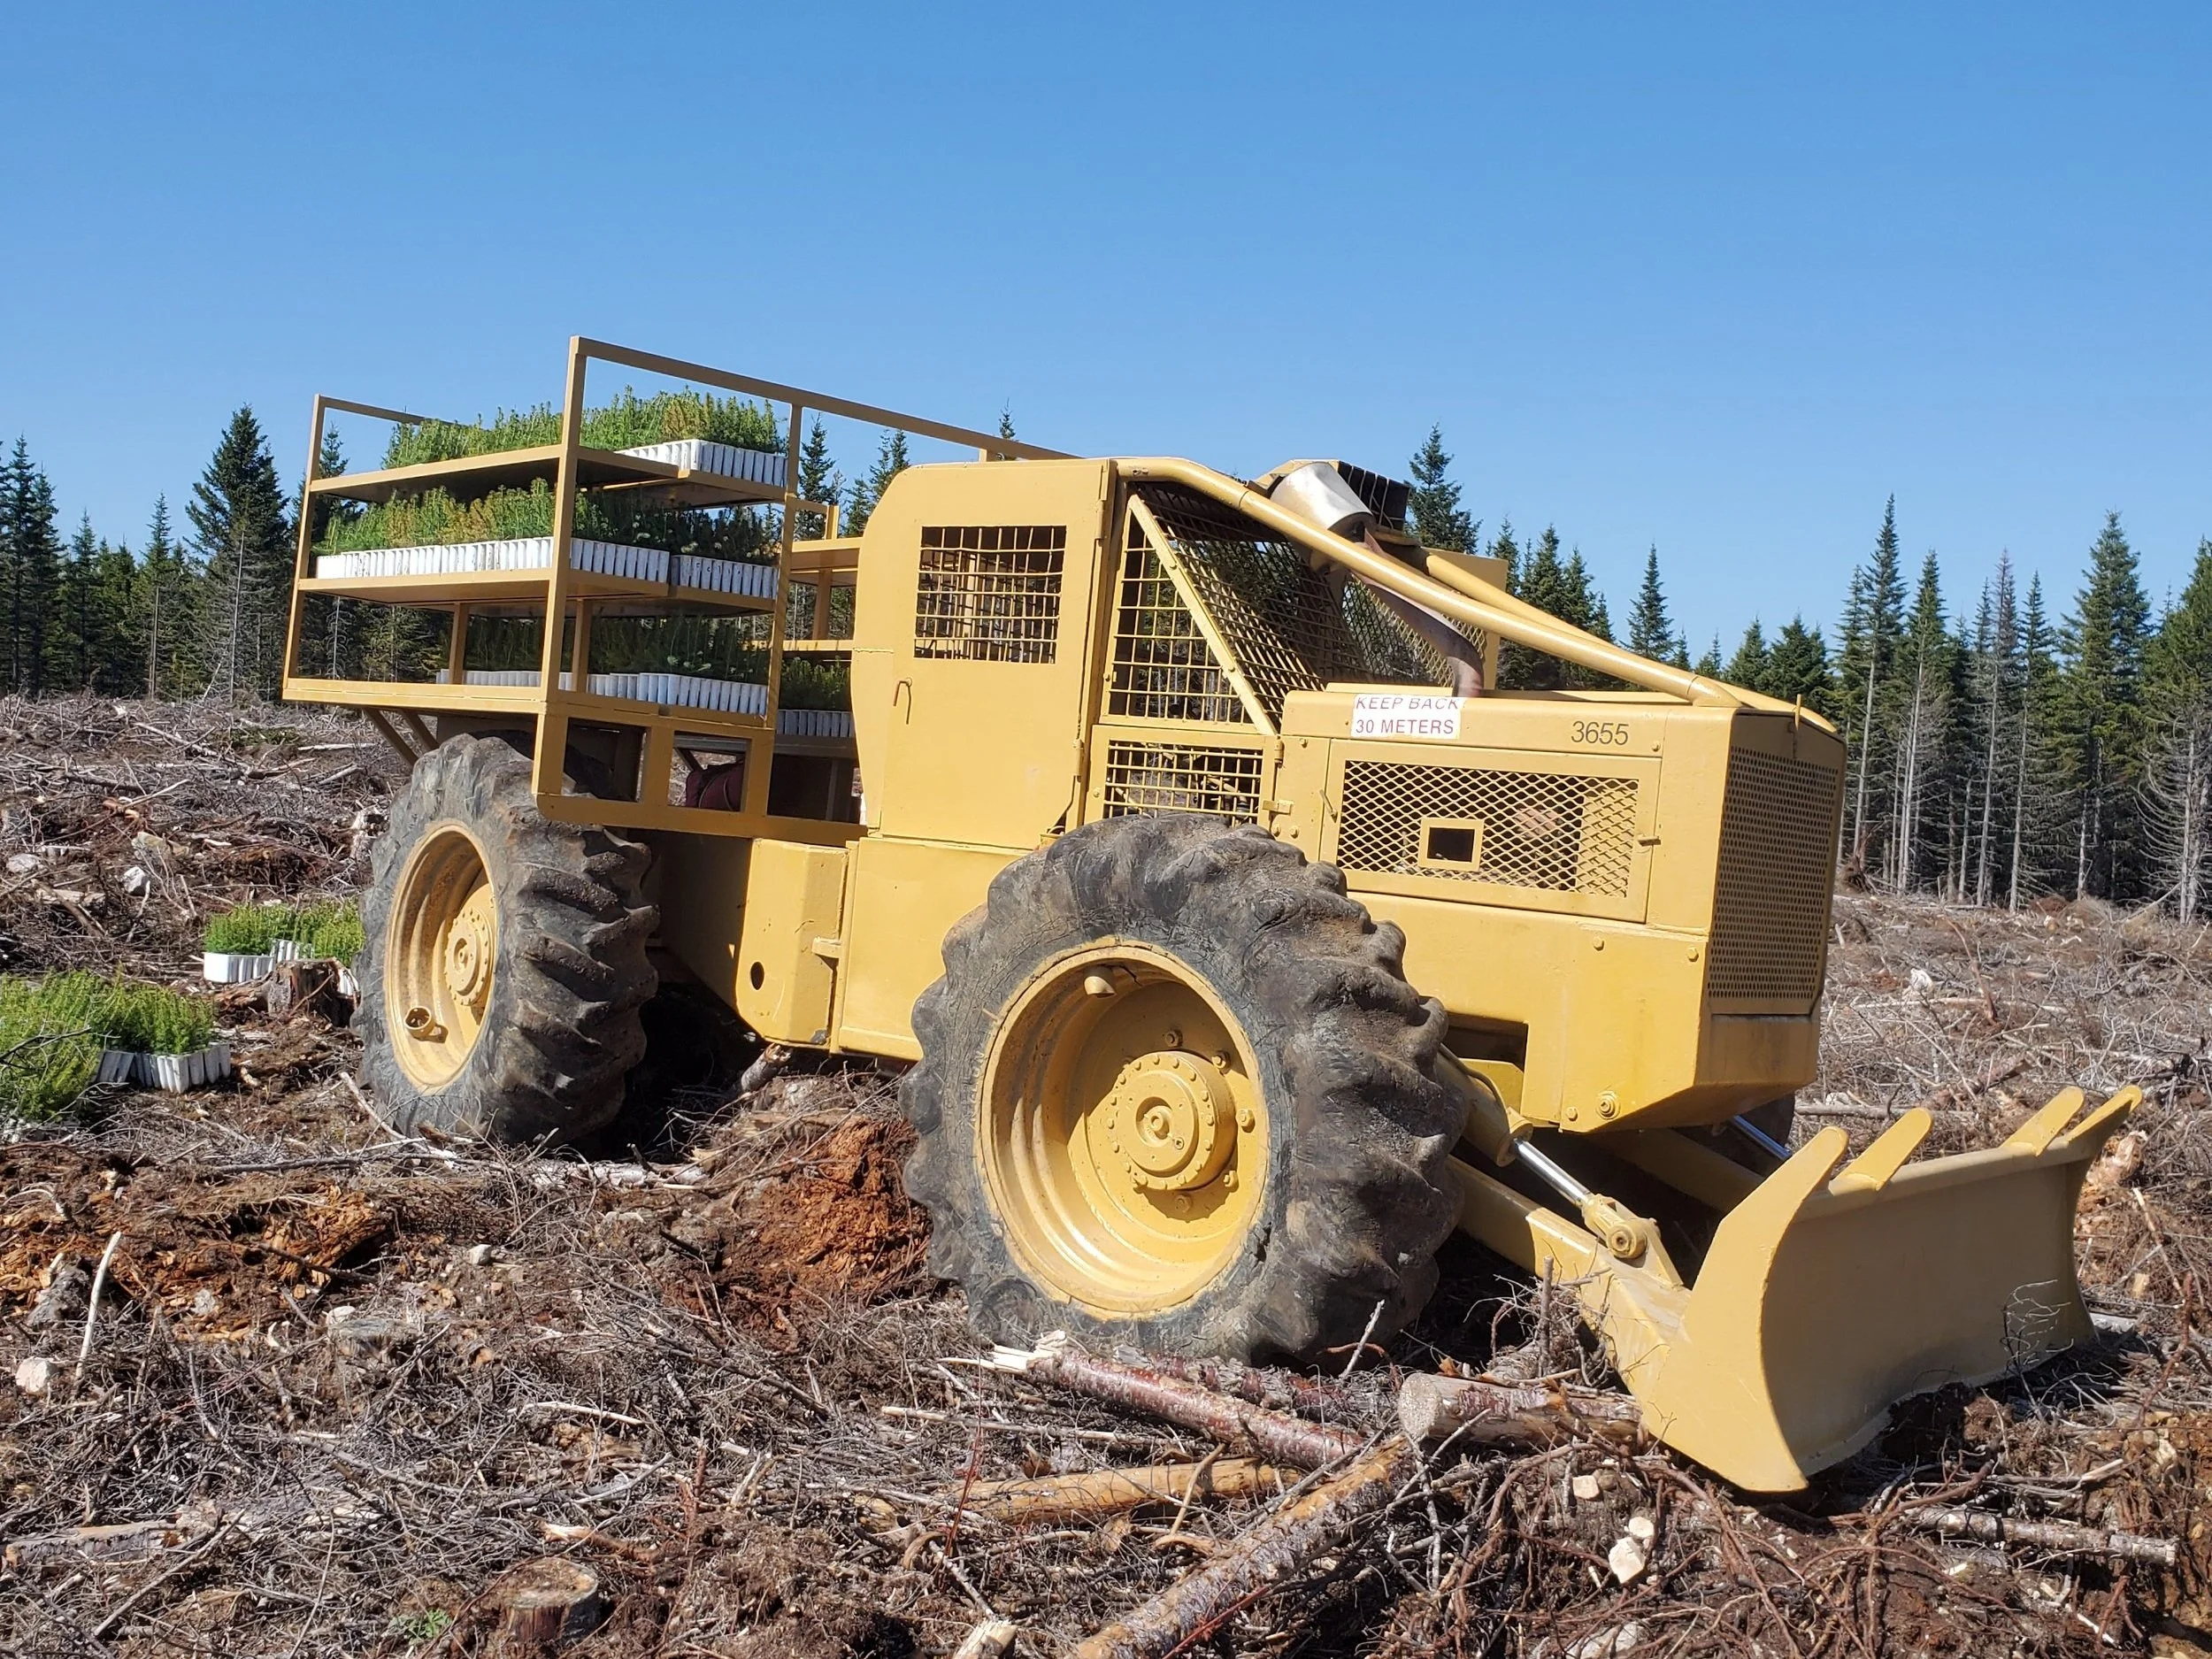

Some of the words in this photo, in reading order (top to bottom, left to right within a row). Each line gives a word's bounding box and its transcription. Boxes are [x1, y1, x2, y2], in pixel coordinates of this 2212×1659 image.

[1356, 696, 1403, 710] KEEP
[1409, 697, 1459, 710] BACK
[1356, 719, 1375, 733] 30
[1380, 719, 1454, 734] METERS
[1571, 720, 1629, 746] 3655
